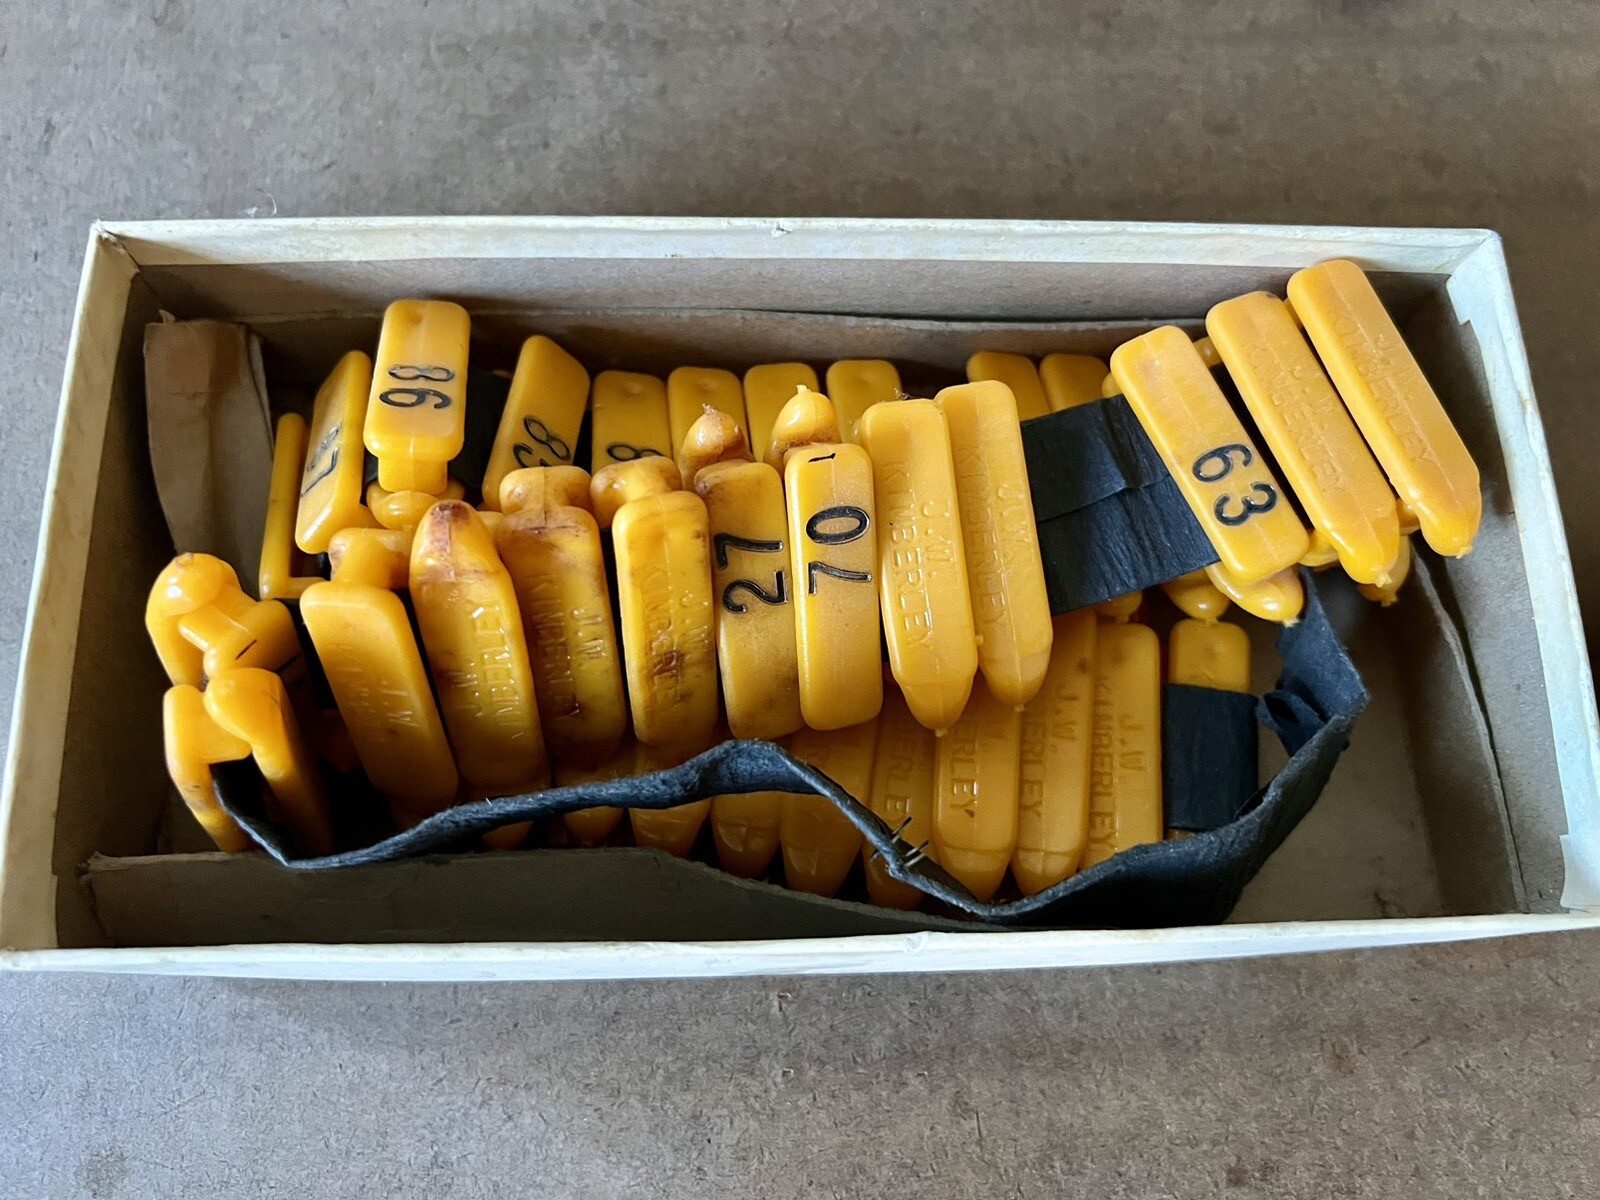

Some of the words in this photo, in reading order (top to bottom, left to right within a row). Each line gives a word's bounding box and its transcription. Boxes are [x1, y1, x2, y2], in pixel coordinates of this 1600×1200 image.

[1192, 443, 1277, 526] 63
[713, 533, 788, 613] 27
[806, 506, 873, 595] 70
[881, 461, 932, 649] KIMBERLEY
